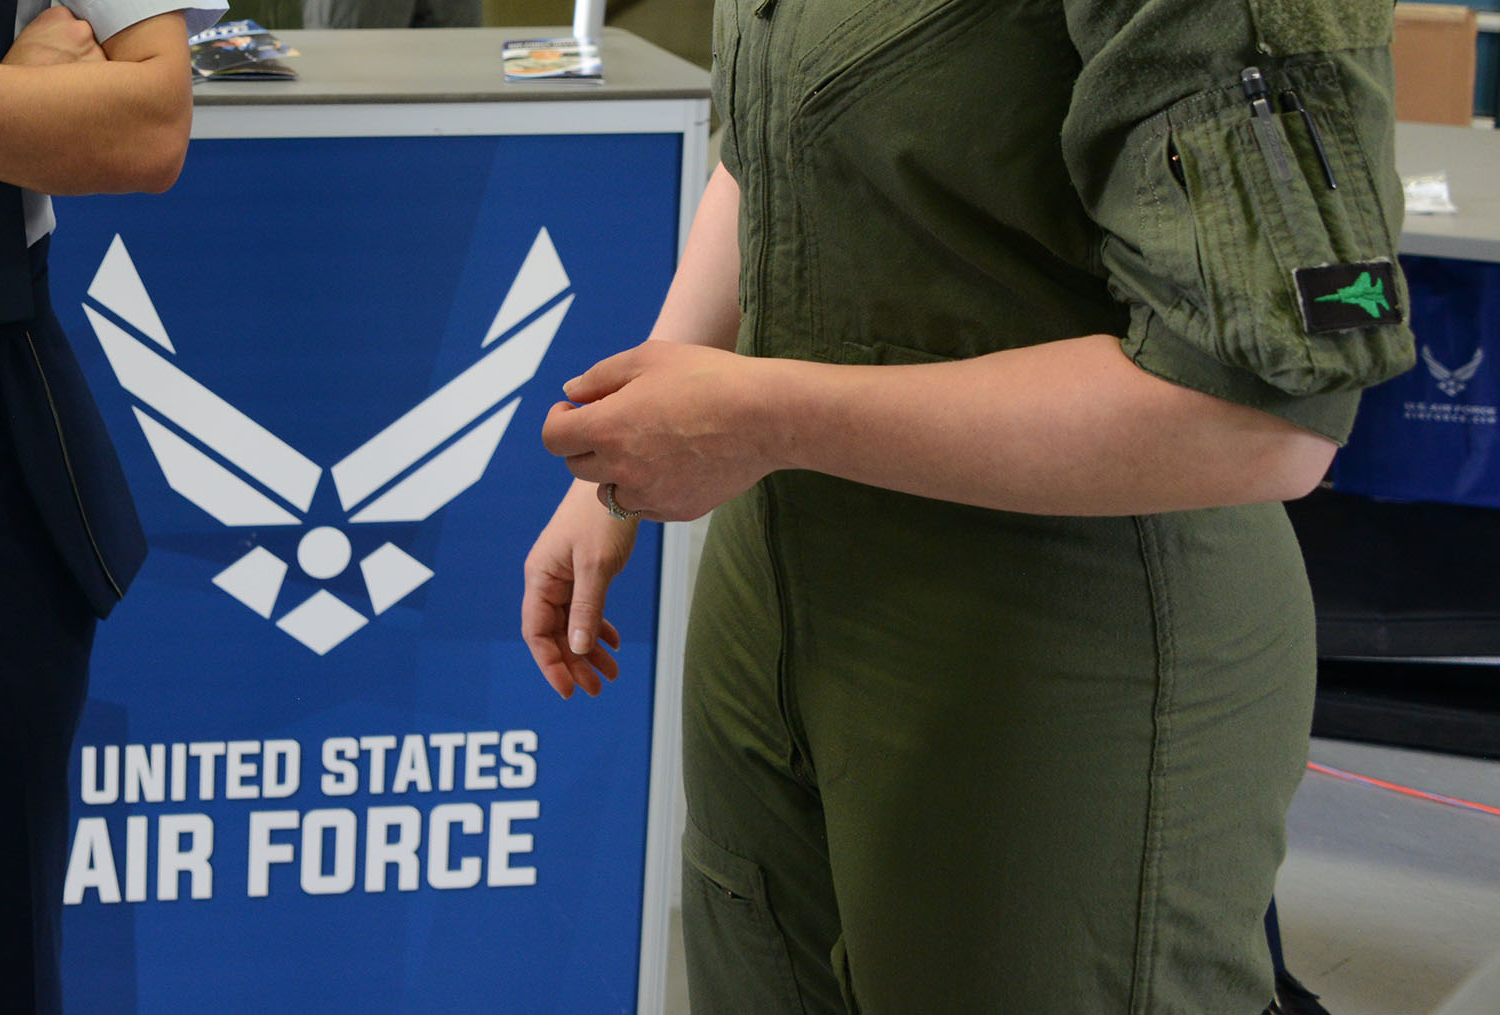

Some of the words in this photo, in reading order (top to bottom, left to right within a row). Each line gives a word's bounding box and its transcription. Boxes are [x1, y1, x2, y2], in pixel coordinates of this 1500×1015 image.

[81, 739, 301, 805] UNITED
[321, 730, 538, 796] STATES
[62, 813, 214, 904] AIR
[247, 800, 540, 897] FORCE
